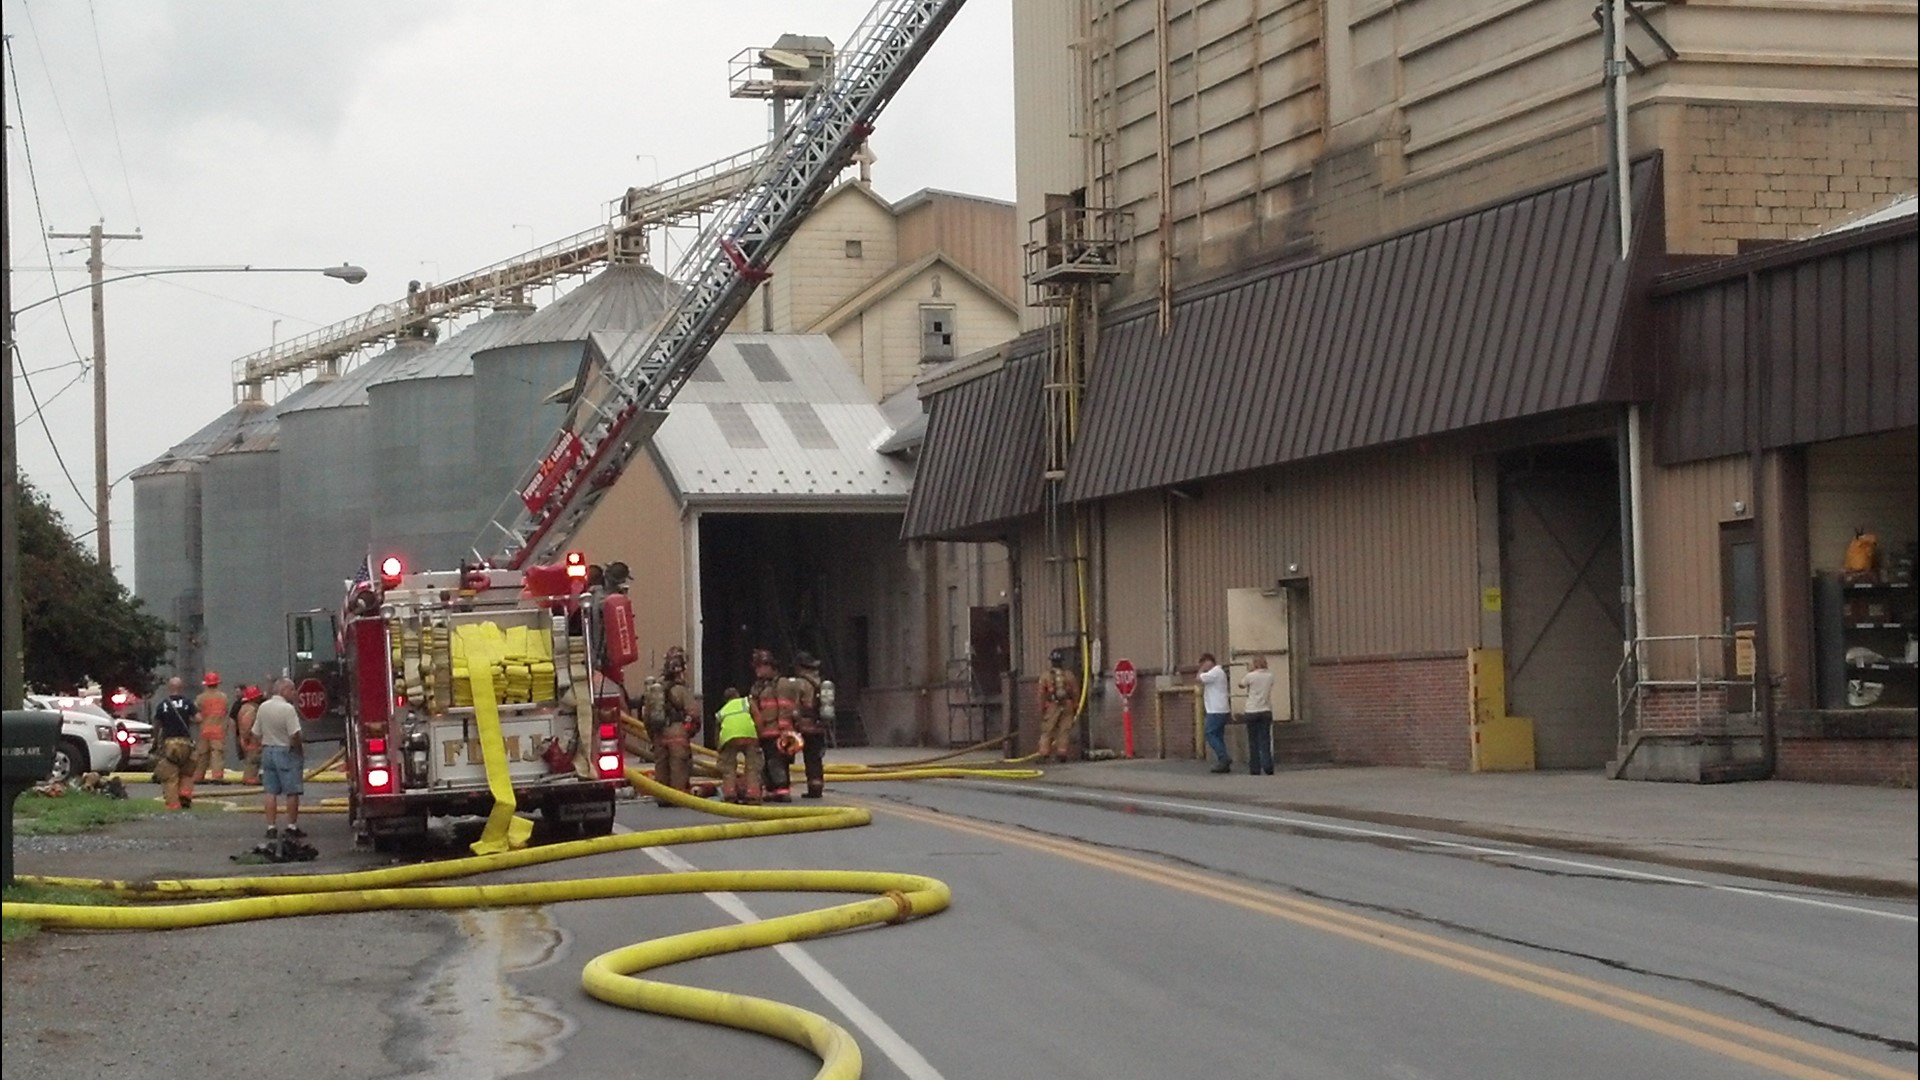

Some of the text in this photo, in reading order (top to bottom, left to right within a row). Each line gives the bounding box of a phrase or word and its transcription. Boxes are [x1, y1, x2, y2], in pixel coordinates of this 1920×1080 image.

[551, 432, 573, 462] LADDER
[1115, 669, 1135, 684] STOP
[299, 691, 325, 707] STOP
